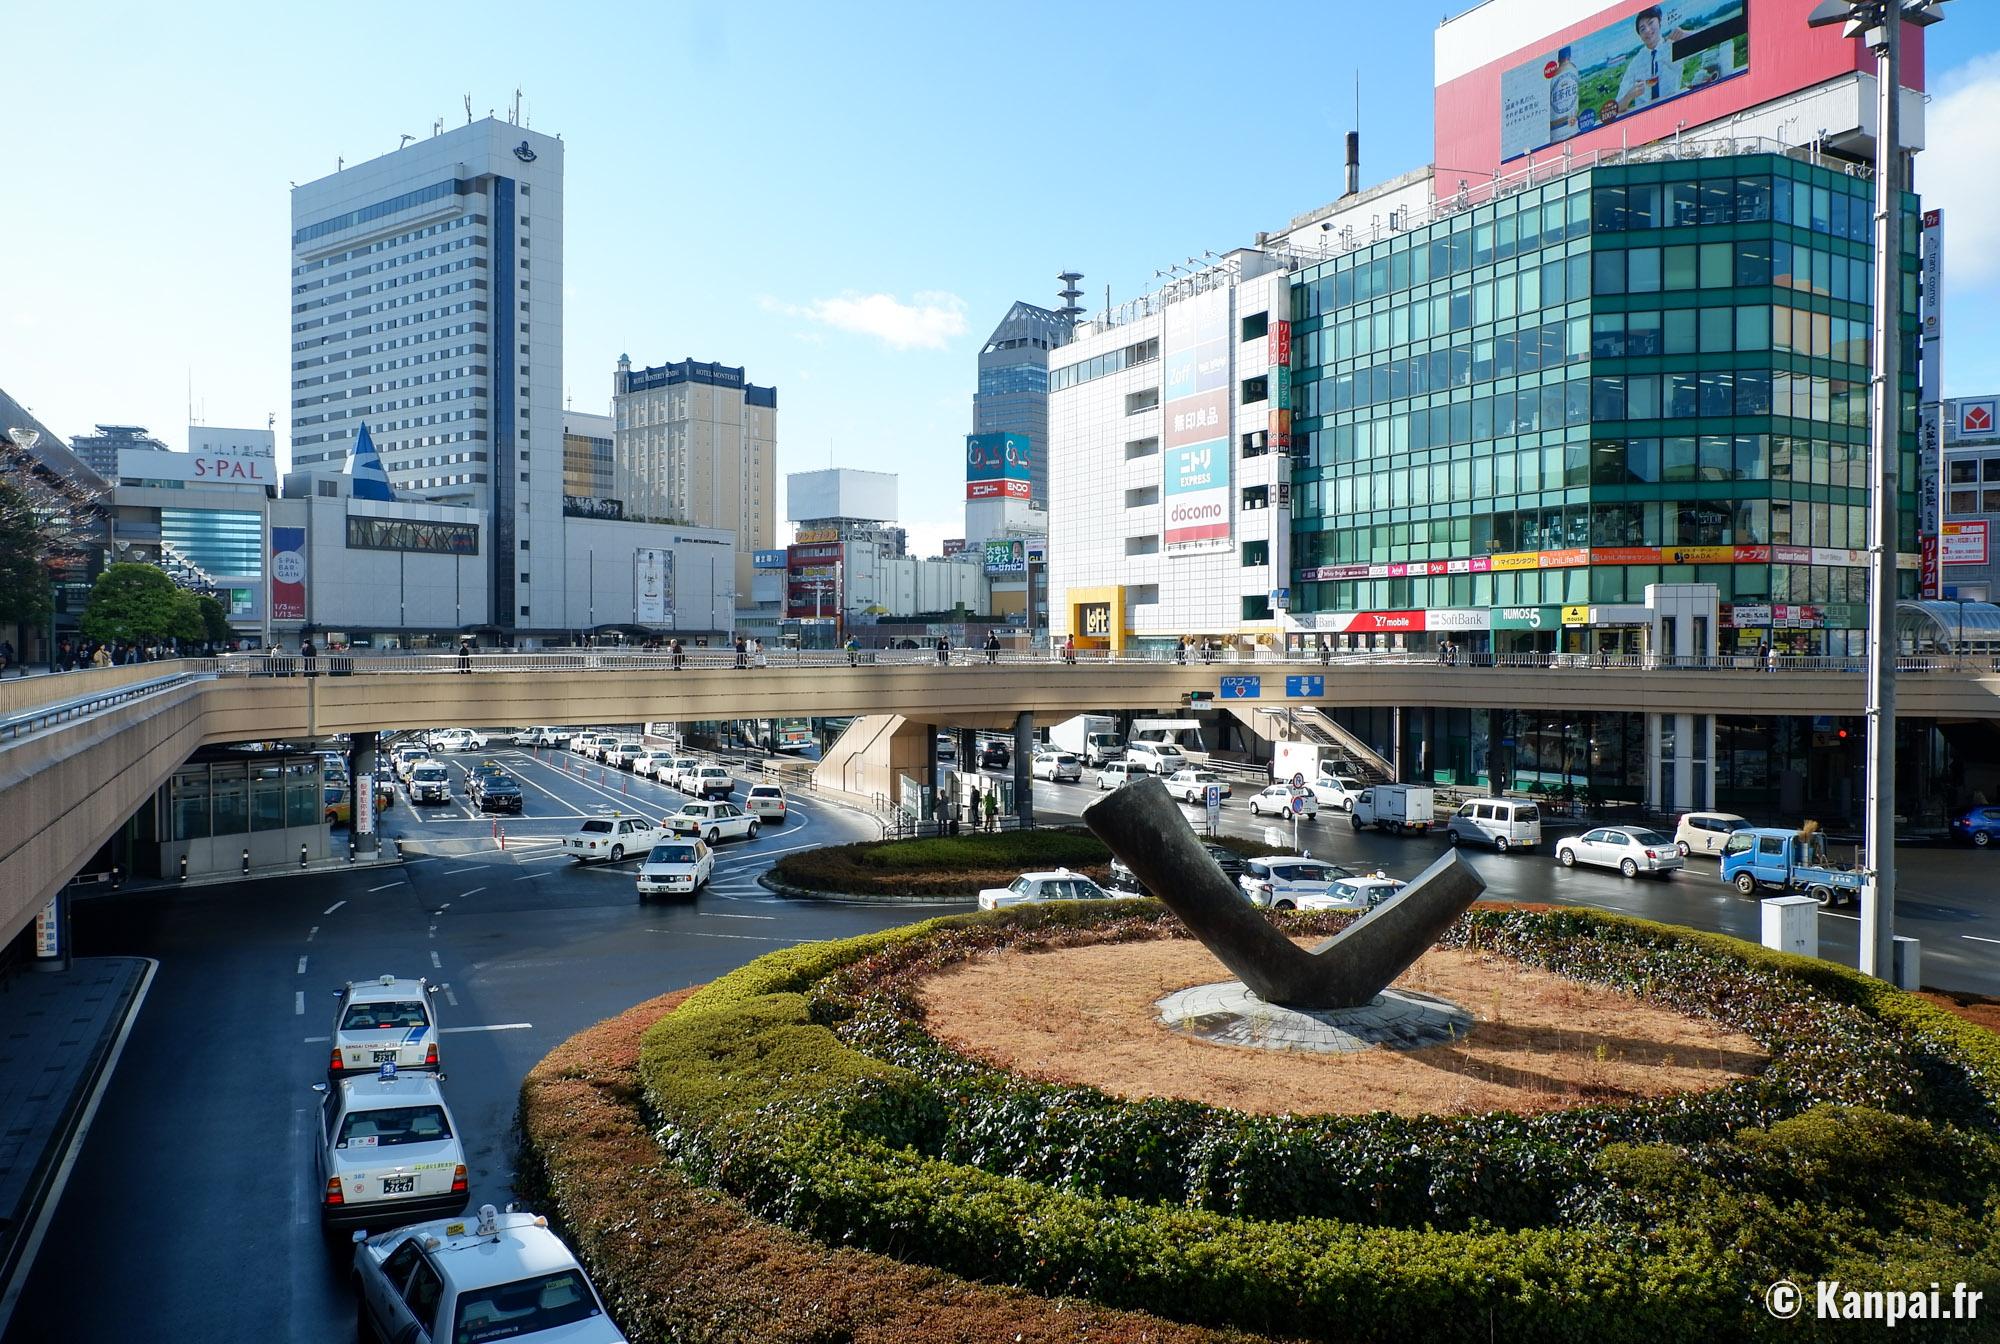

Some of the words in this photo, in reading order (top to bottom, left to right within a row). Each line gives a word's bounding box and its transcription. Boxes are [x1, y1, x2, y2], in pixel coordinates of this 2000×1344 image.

[1925, 214, 1939, 226] 9F
[1928, 252, 1936, 272] trans
[1279, 322, 1289, 363] リーブ21
[696, 369, 712, 377] HOTEL
[713, 372, 740, 381] MONTEREY
[1169, 361, 1192, 385] Zoff
[1174, 406, 1218, 432] 無印良品
[1180, 448, 1211, 474] ニトリ
[195, 458, 263, 480] S-PAL
[1180, 472, 1211, 487] EXPRESS
[973, 485, 998, 496] エンドー
[1007, 482, 1028, 492] ENDO
[1171, 504, 1221, 522] docomo
[986, 545, 1009, 555] 大きい
[1734, 550, 1769, 560] リーブ21
[986, 554, 1009, 563] サイズ
[1500, 556, 1537, 566] マイコンタクト
[1924, 539, 1936, 585] リーブ21
[274, 603, 288, 611] 1/3
[1304, 617, 1337, 629] SoftBank
[1441, 613, 1482, 625] SoftBank
[1221, 676, 1259, 687] バスプール
[389, 1182, 413, 1193] 26-67
